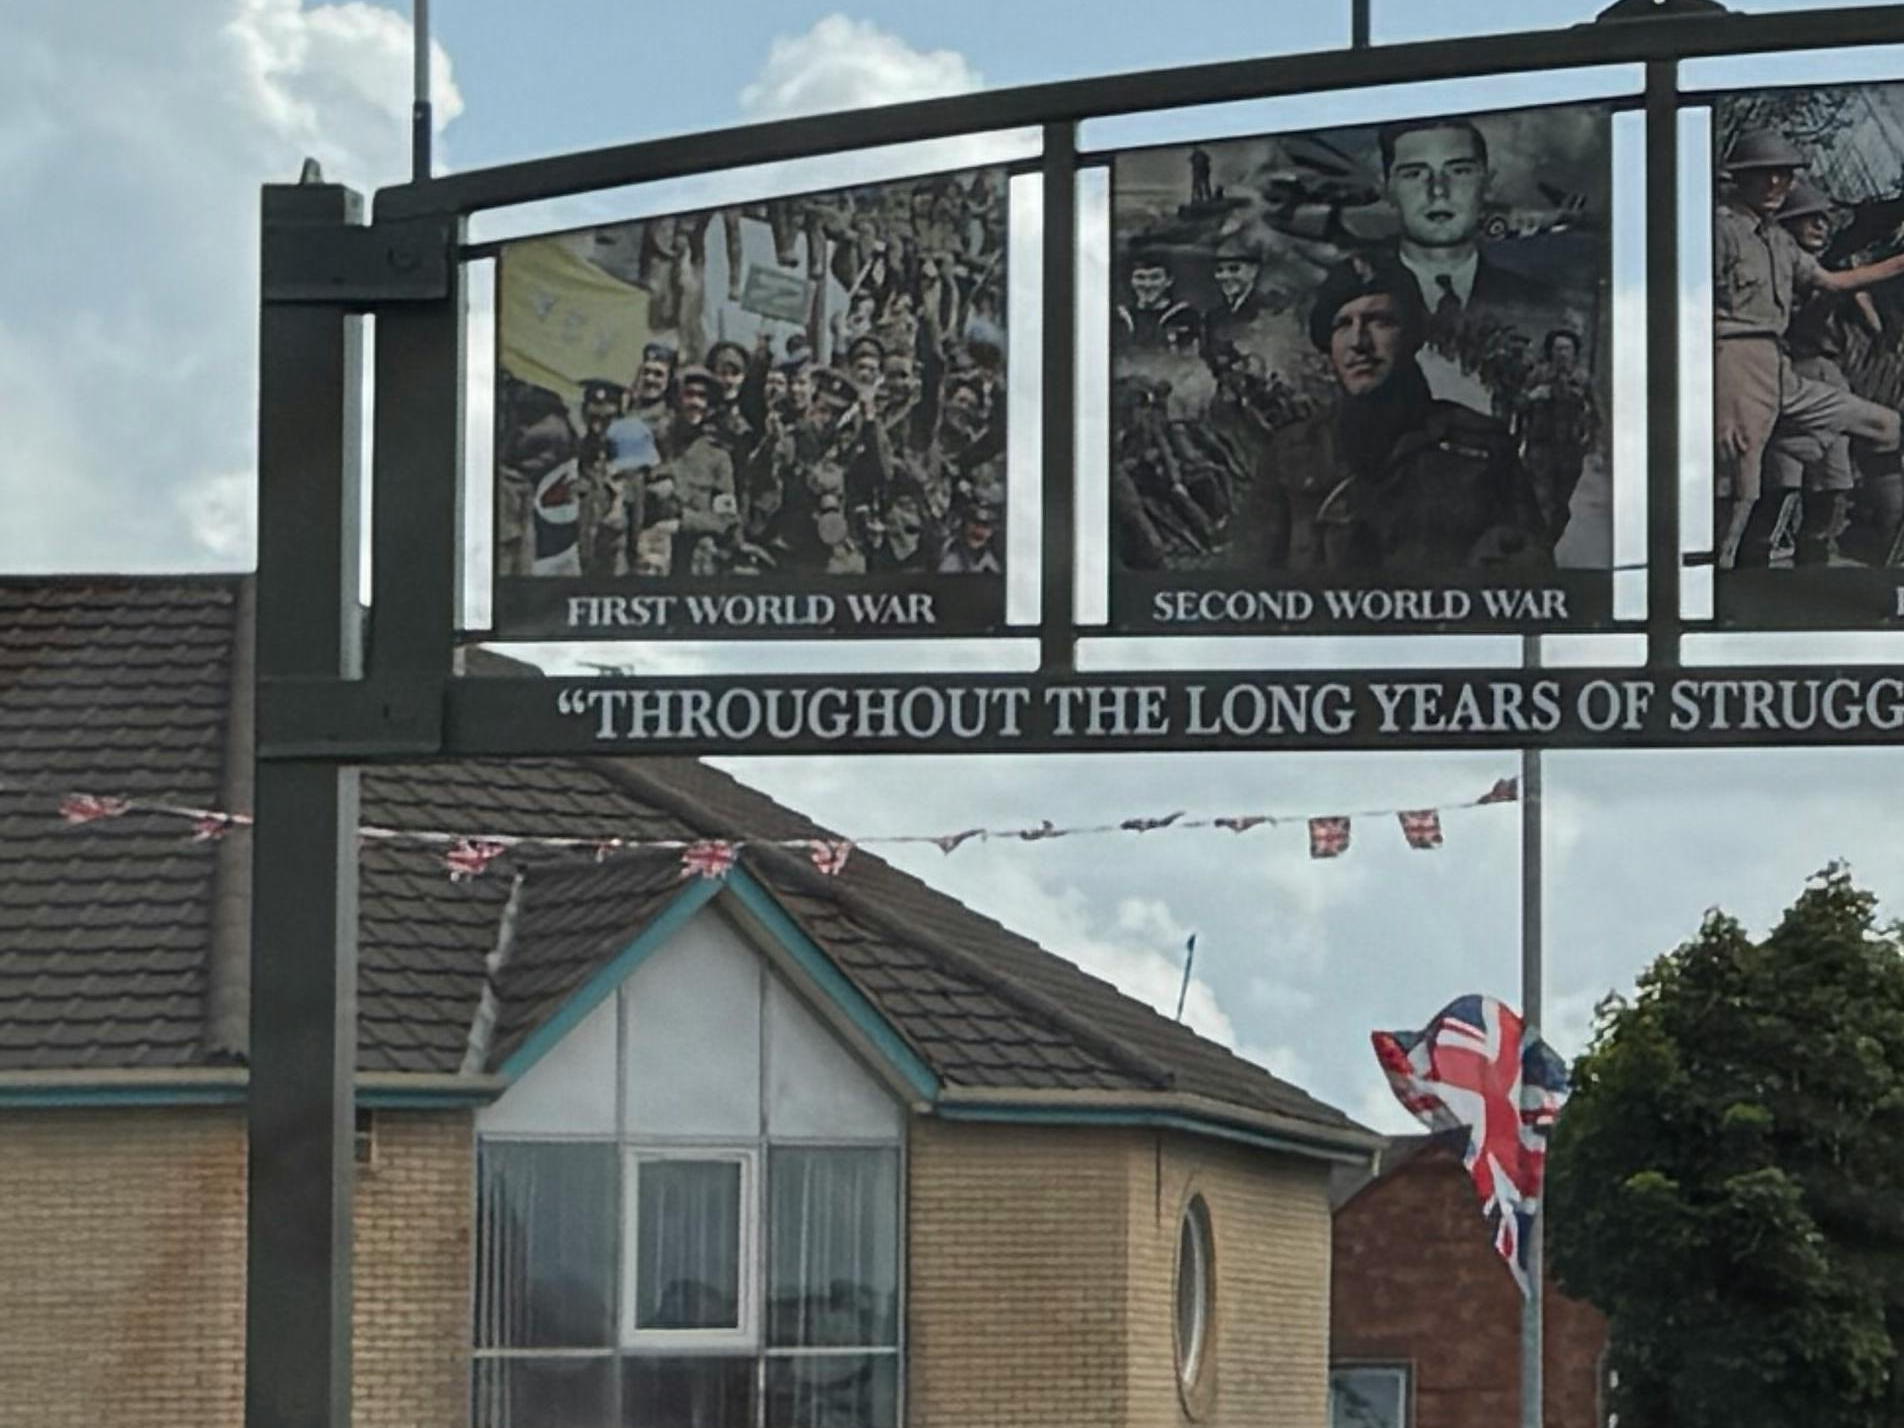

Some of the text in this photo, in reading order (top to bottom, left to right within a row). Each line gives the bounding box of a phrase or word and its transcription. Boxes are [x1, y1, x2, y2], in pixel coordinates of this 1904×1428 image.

[567, 593, 937, 627] FIRST WORLD WAR
[1152, 589, 1569, 622] SECOND WORLD WAR
[1045, 684, 1170, 737] THE
[1185, 683, 1356, 736] LONG
[1369, 680, 1560, 733] YEARS
[1576, 680, 1655, 732] OF
